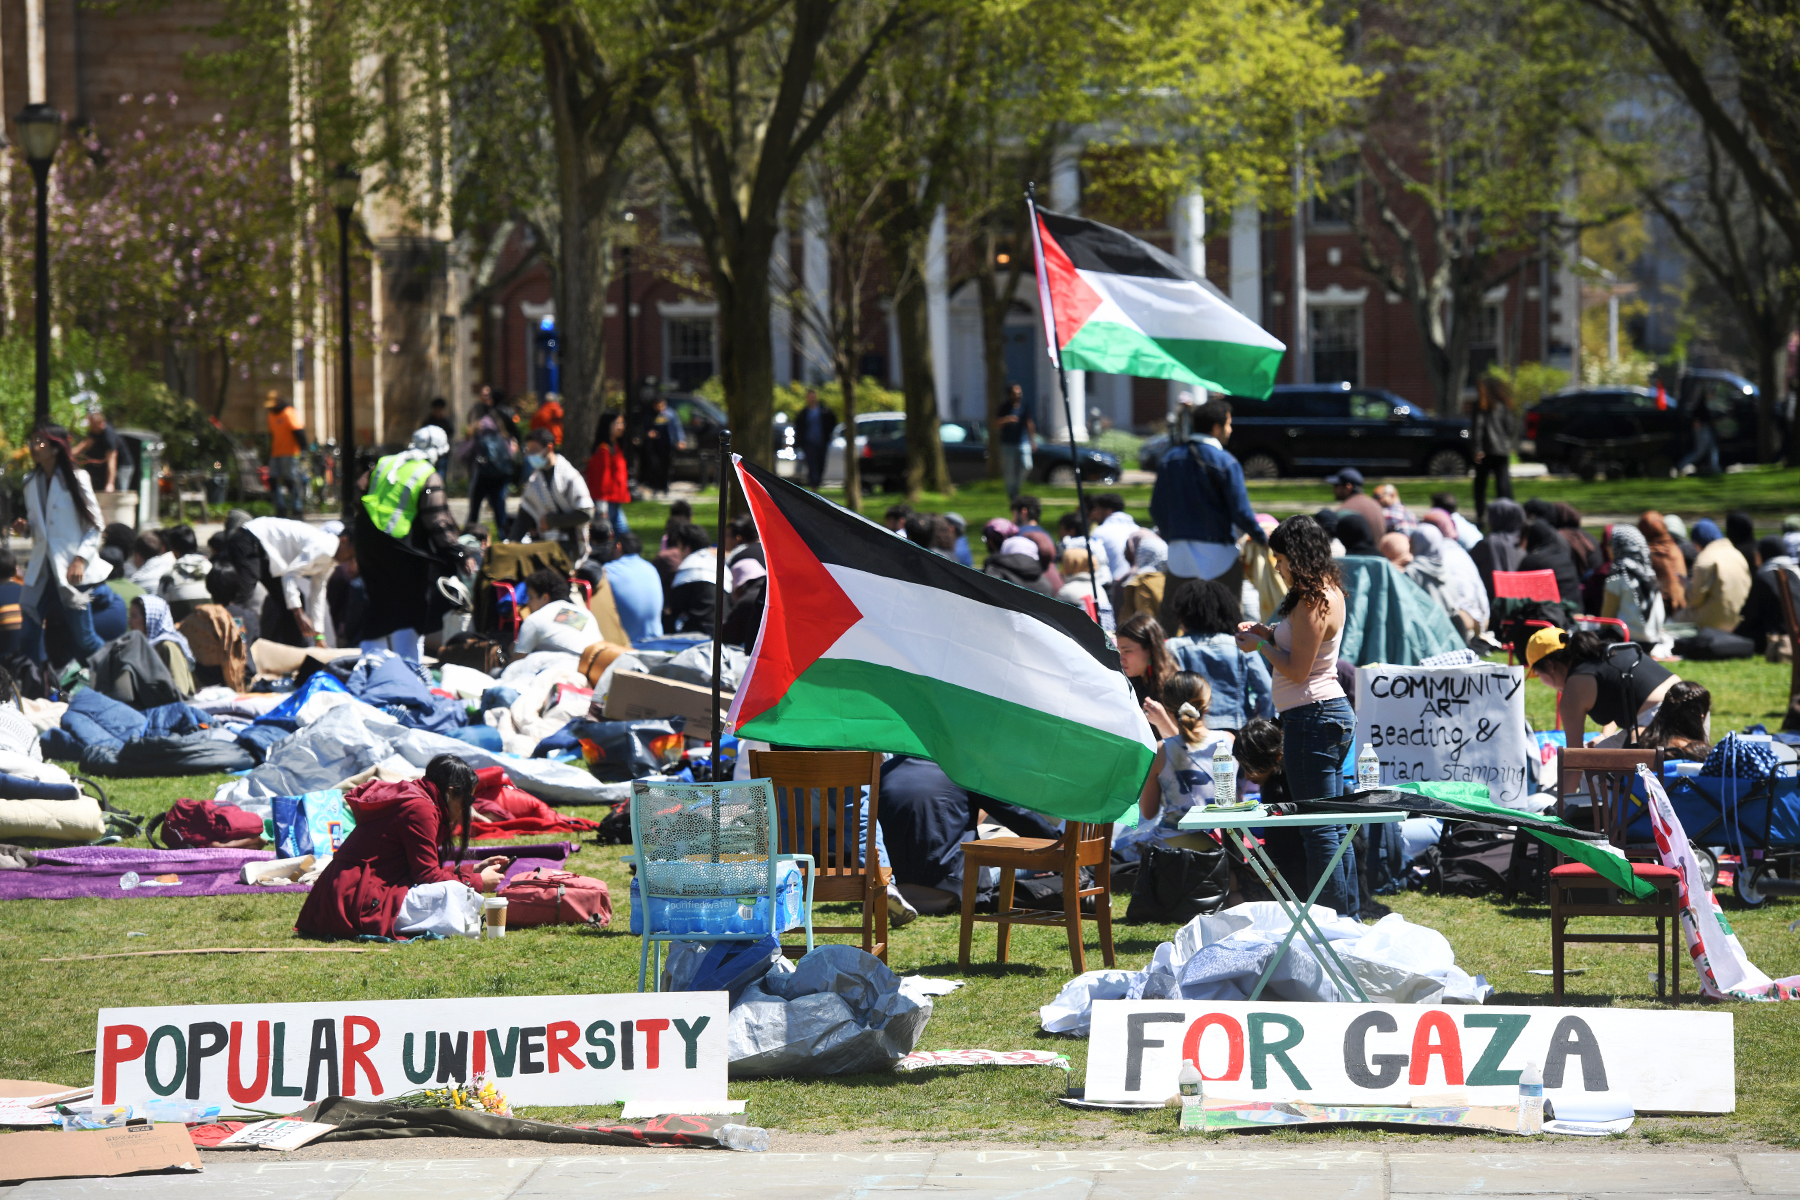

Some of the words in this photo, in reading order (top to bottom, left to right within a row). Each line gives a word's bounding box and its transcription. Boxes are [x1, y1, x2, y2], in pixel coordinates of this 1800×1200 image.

[1370, 673, 1521, 701] COMMUNITY
[1419, 698, 1470, 718] ART
[1370, 719, 1472, 761] Beading
[1475, 718, 1502, 742] &
[1439, 760, 1526, 803] stamping
[705, 901, 733, 909] water
[102, 1015, 383, 1105] POPULAR
[403, 1016, 711, 1083] UNIVERSITY
[1125, 1012, 1312, 1092] FOR
[1344, 1010, 1609, 1092] GAZA
[1031, 1160, 1356, 1171] DIVEST
